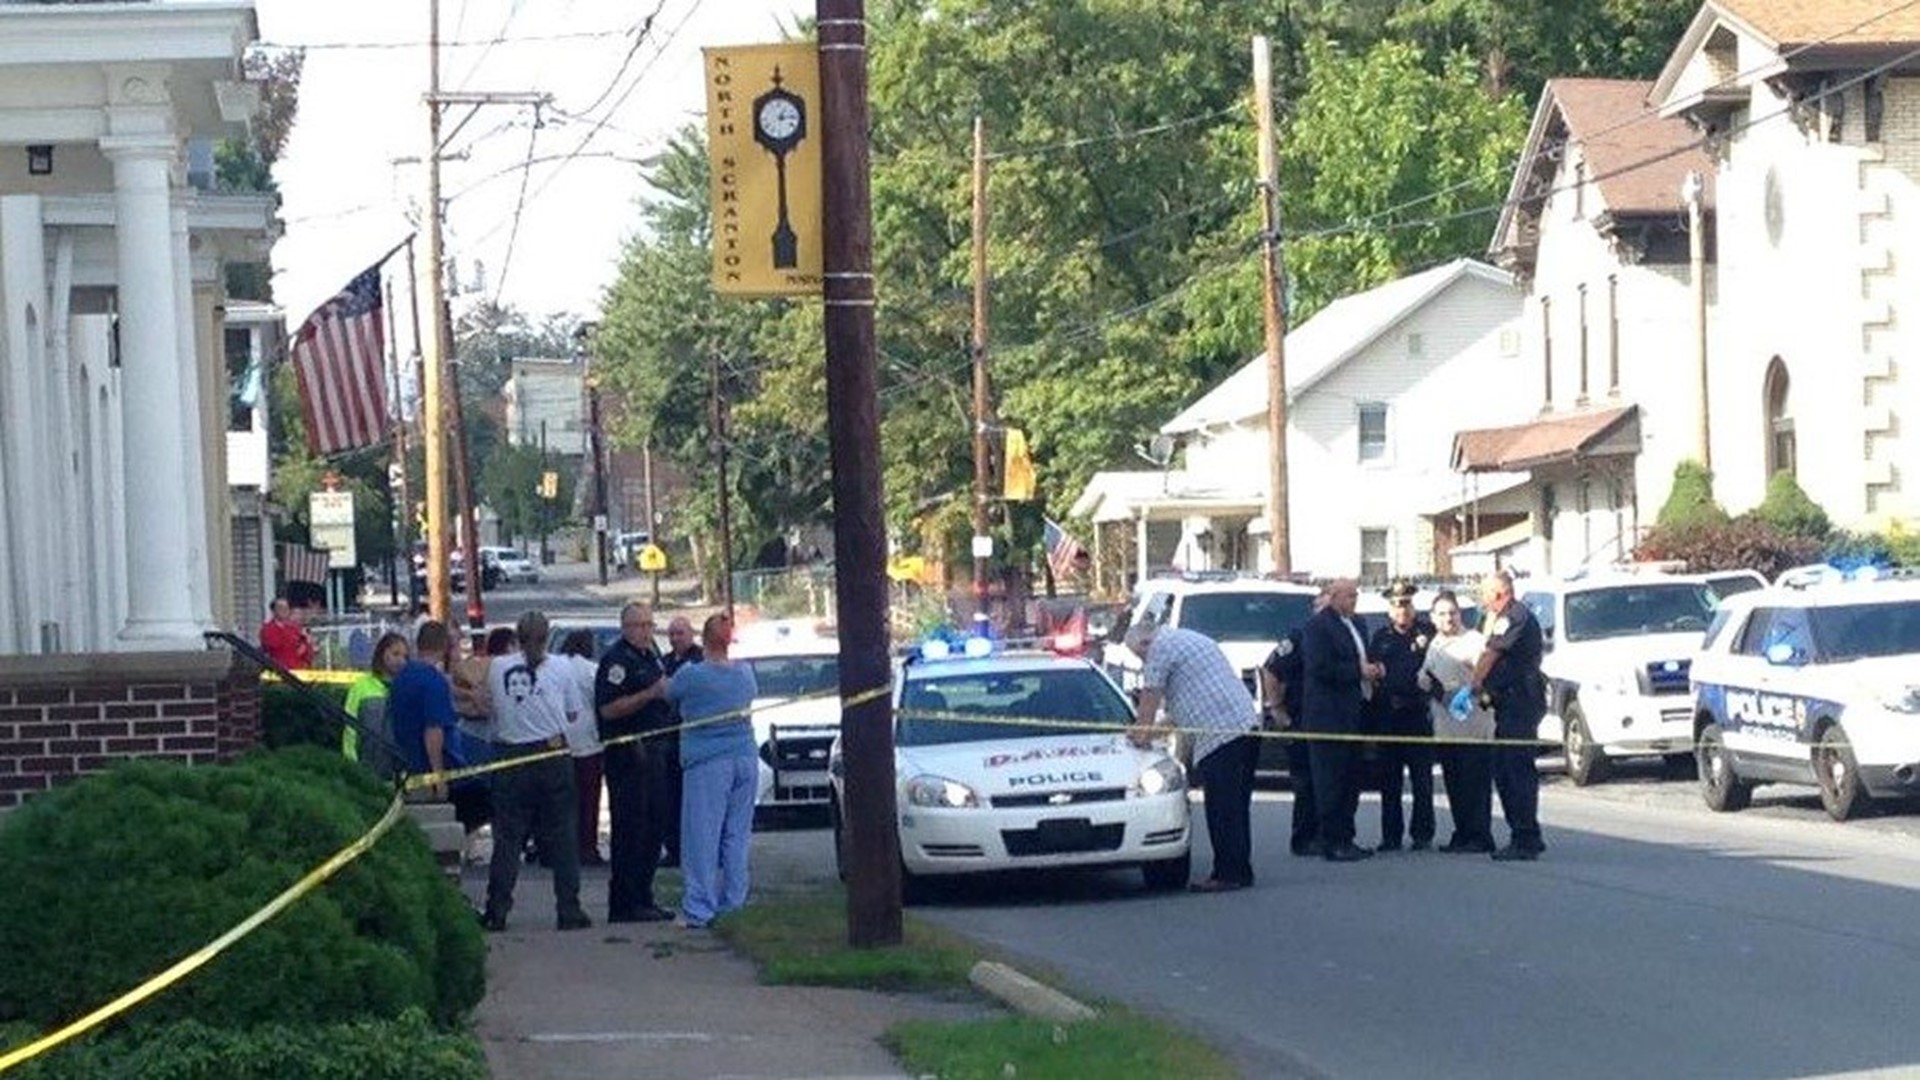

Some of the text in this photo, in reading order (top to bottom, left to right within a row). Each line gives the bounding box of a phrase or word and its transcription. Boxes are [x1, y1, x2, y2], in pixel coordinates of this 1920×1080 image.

[714, 57, 740, 282] NORTH SCRANTON
[1726, 690, 1797, 729] POLICE
[1008, 772, 1103, 786] POLICE
